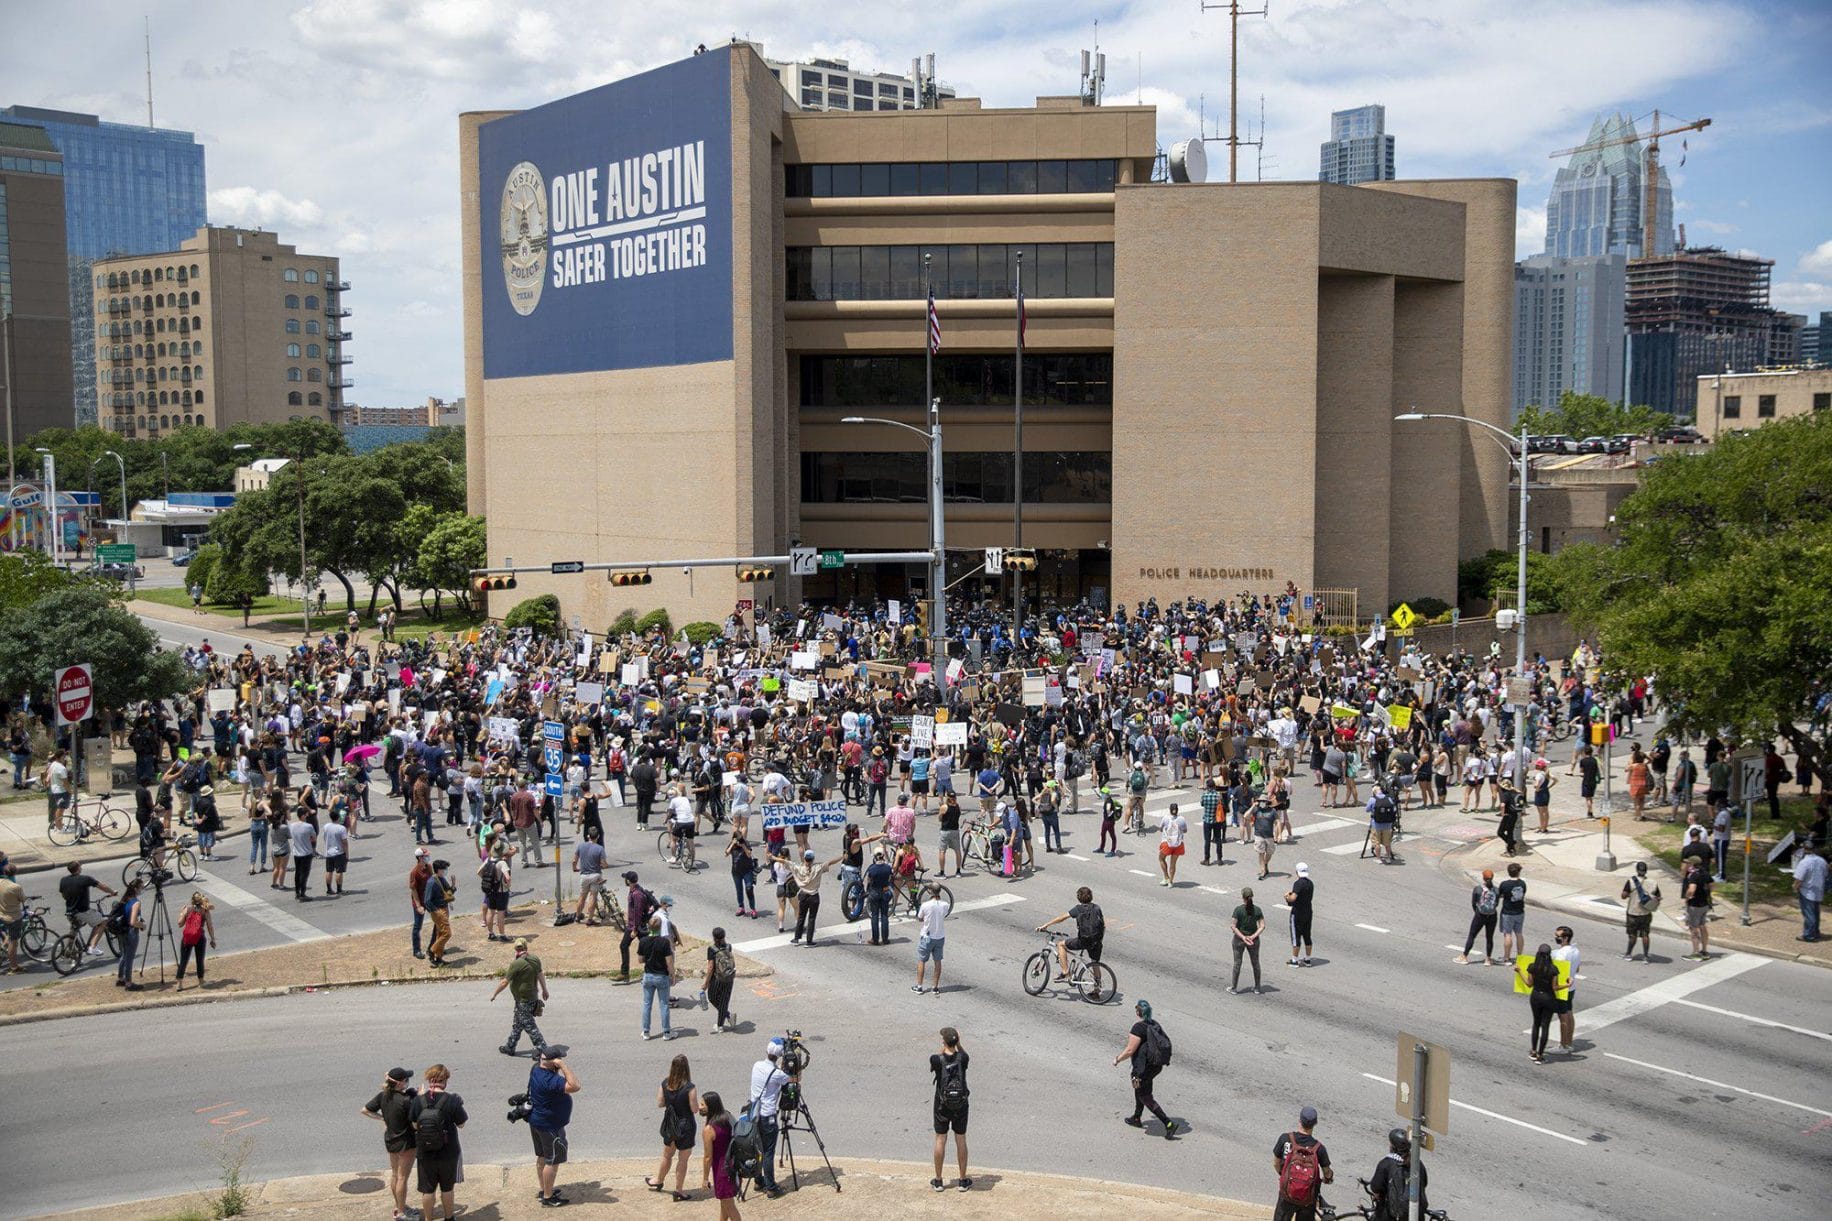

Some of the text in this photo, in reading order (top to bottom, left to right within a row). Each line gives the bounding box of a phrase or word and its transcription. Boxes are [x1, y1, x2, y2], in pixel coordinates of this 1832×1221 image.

[508, 171, 540, 199] AUSTIN
[552, 140, 705, 232] ONE AUSTIN
[553, 224, 706, 288] SAFER TOGETHER
[510, 261, 540, 279] POLICE
[11, 493, 41, 507] Gulf
[824, 554, 837, 565] 8th
[1140, 568, 1274, 580] POLICE HEADQUARTERS
[63, 676, 86, 689] DO NOT
[66, 700, 85, 712] ENTER
[545, 724, 564, 739] SOUTH
[547, 749, 561, 768] 35
[762, 800, 846, 816] DEFUND POLICE
[783, 814, 819, 825] BUDGET
